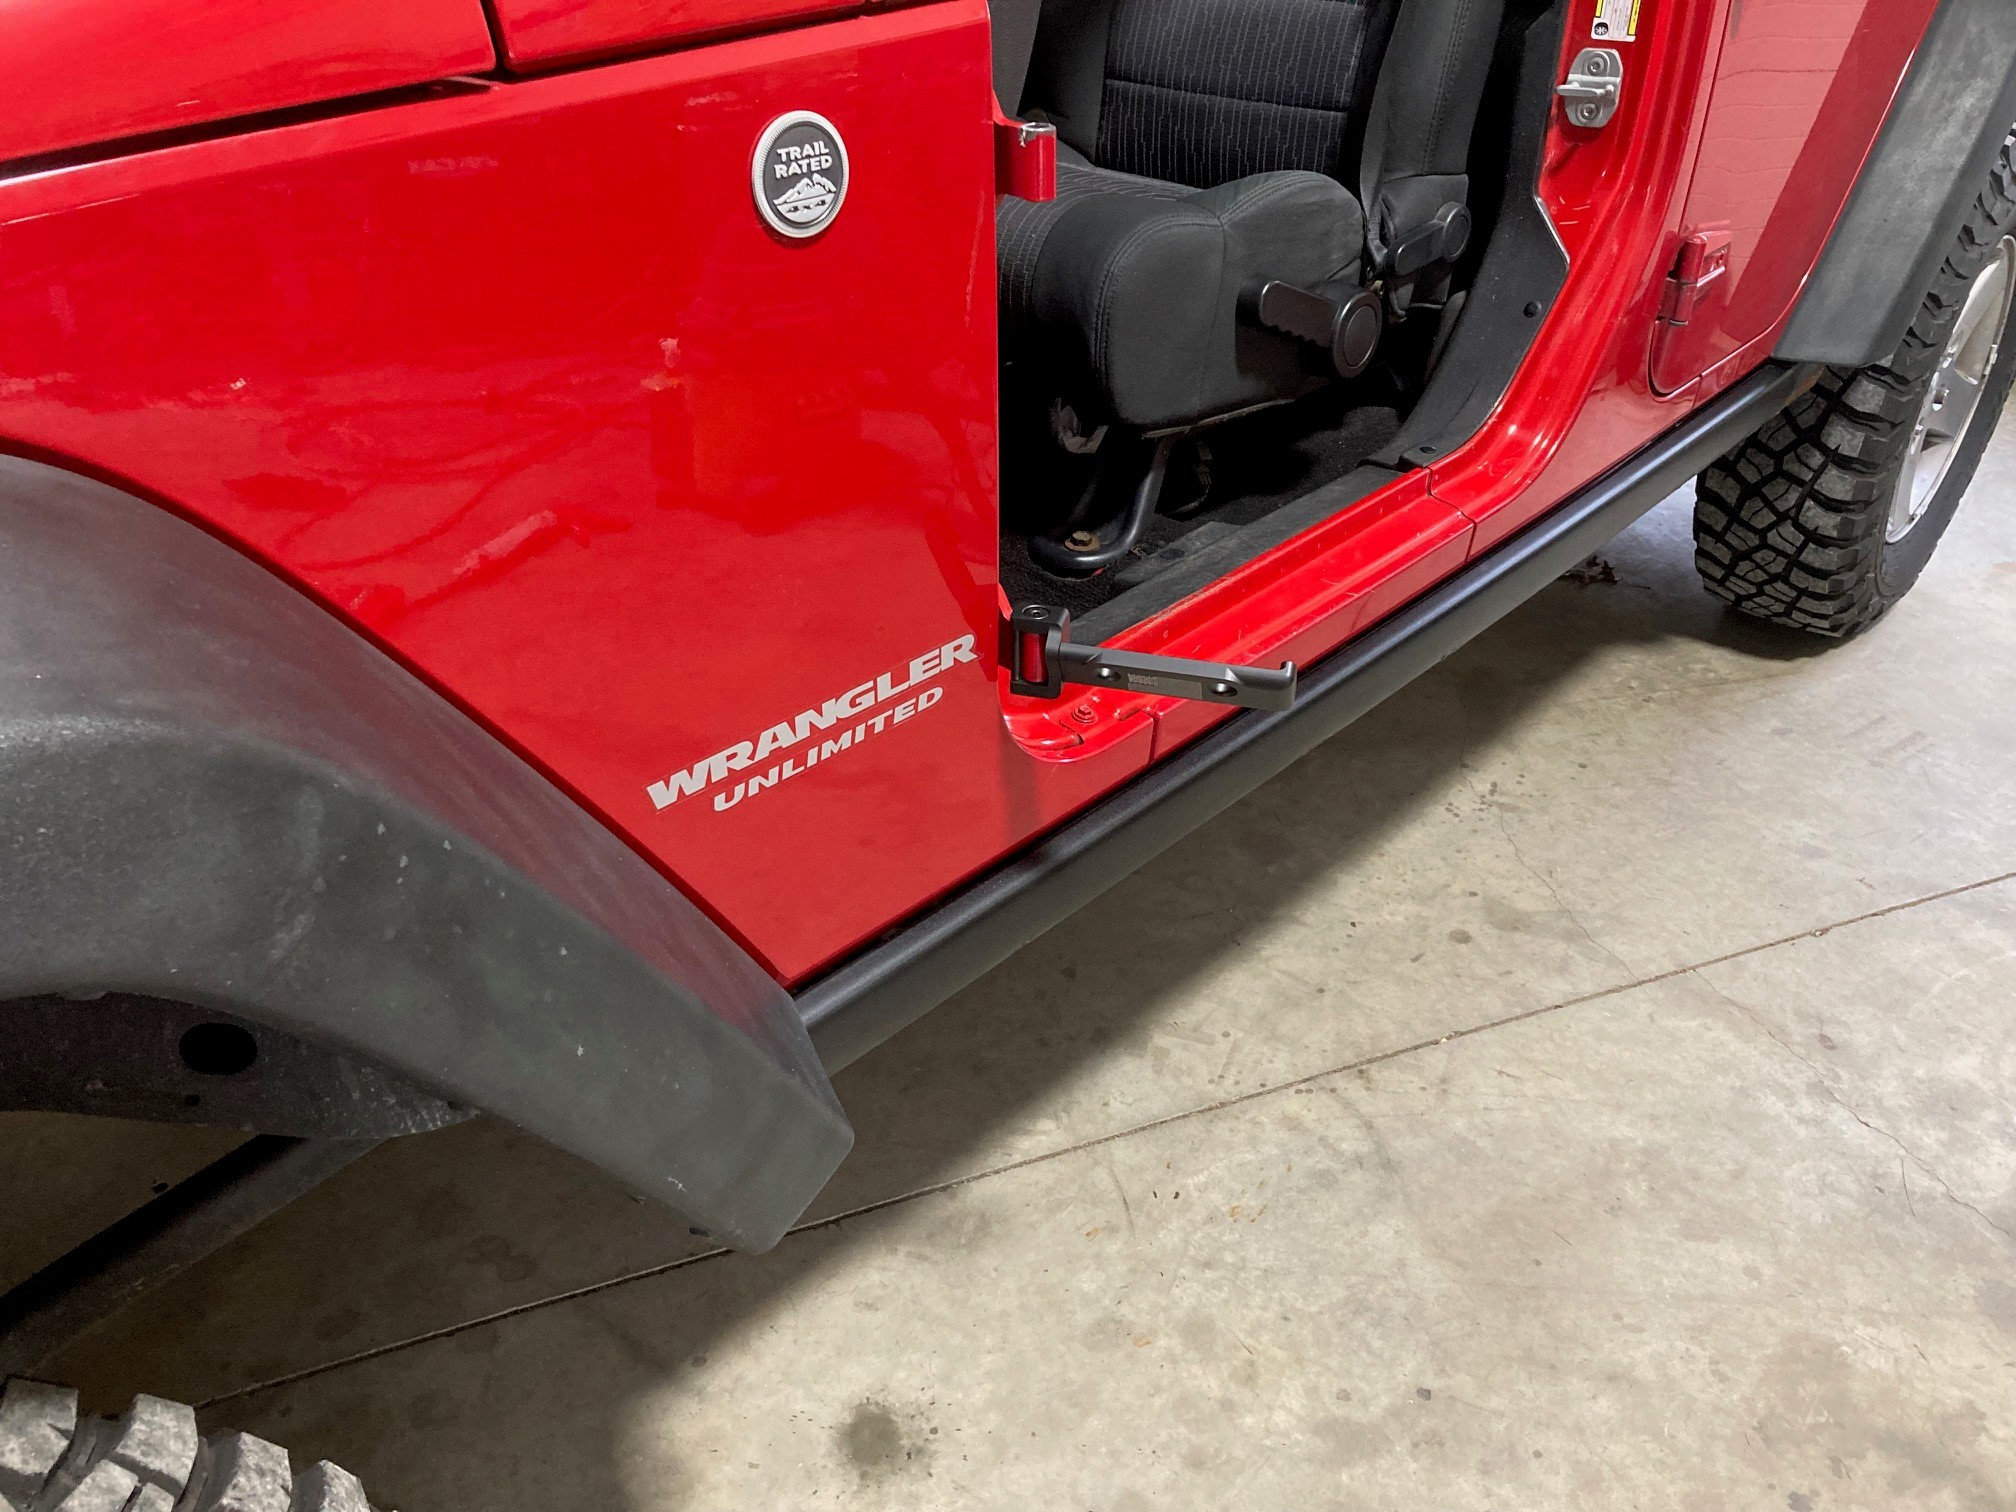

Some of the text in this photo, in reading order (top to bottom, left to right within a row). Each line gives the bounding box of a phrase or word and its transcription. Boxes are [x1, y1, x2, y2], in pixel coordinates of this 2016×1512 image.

[774, 155, 832, 178] RATED
[777, 141, 829, 162] TRAIL
[647, 634, 978, 810] WRANGLER
[714, 687, 943, 812] UNLIMITED
